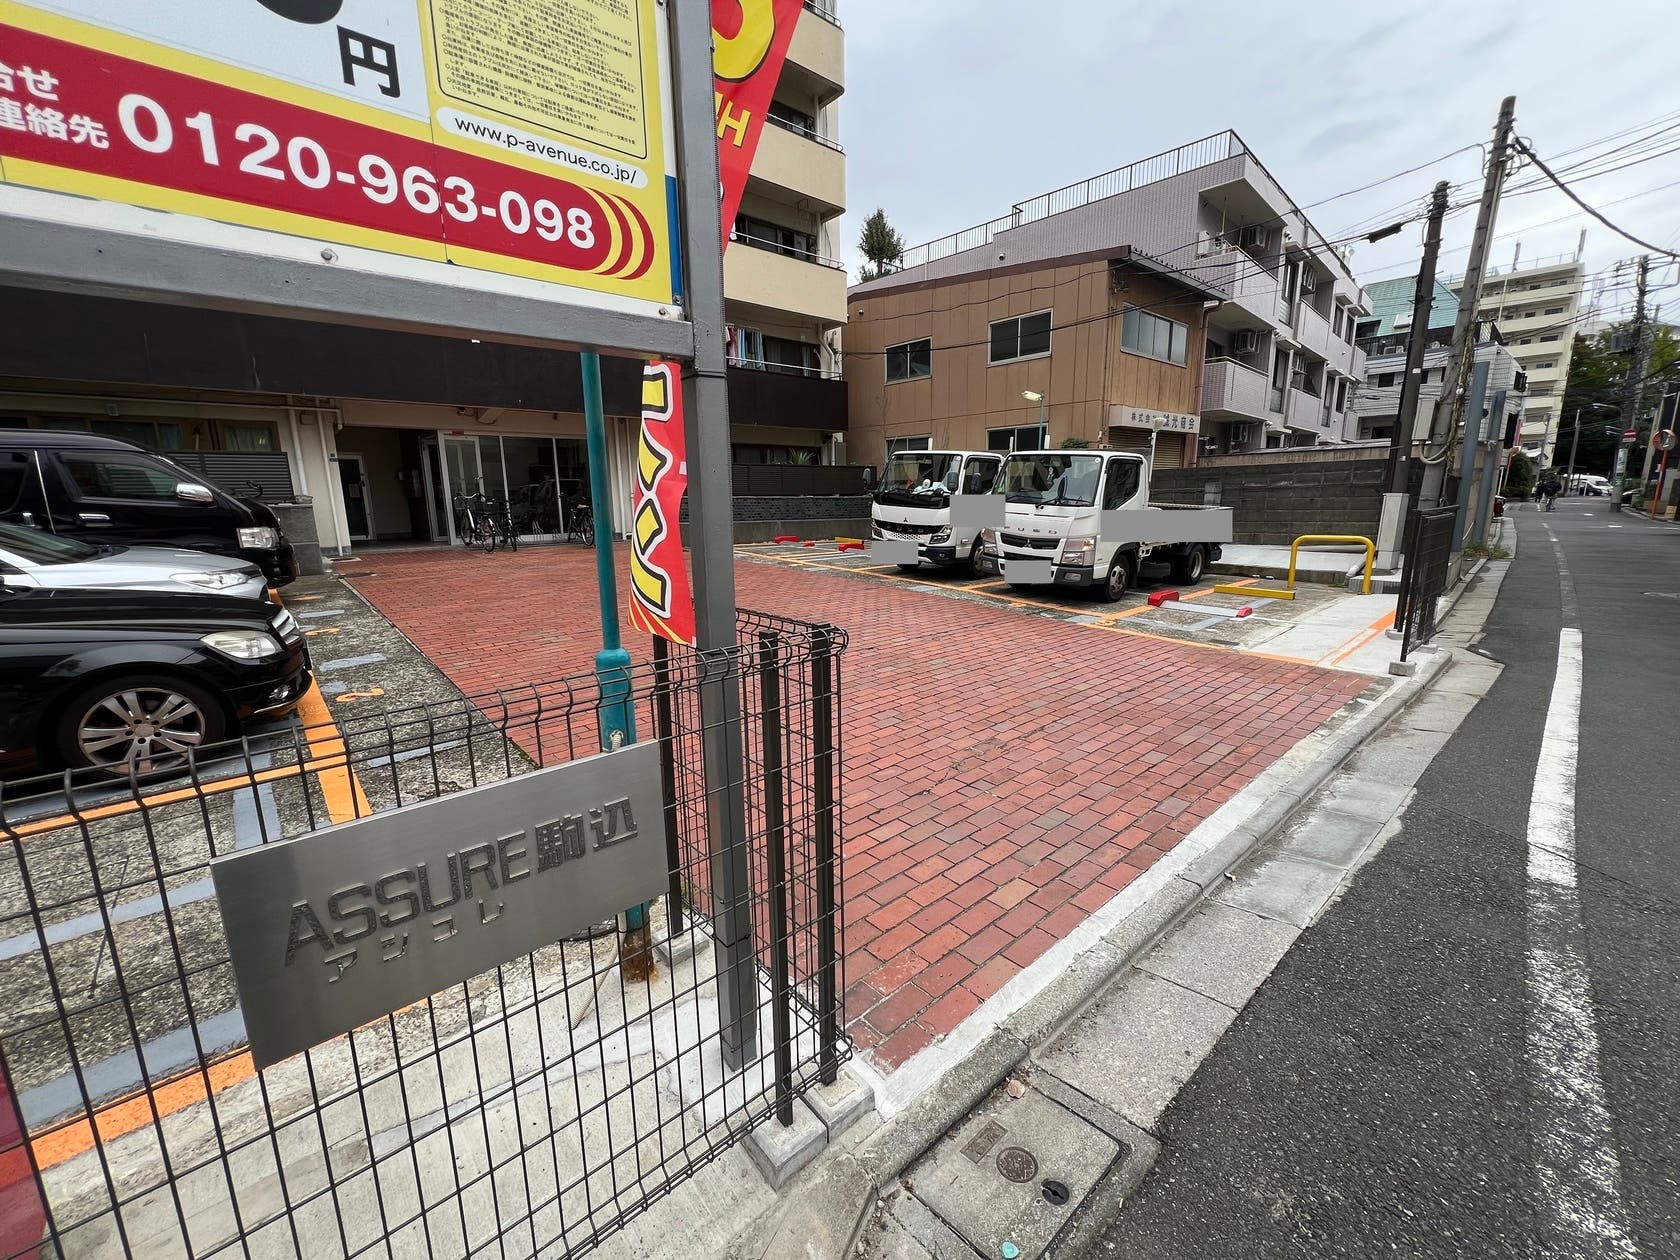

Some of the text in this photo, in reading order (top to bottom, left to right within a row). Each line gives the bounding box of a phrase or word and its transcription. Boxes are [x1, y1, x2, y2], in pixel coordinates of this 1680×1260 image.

[337, 25, 400, 98] 円
[118, 93, 596, 250] 0120-963-098
[454, 117, 637, 184] www.p-avenue.co.jp/
